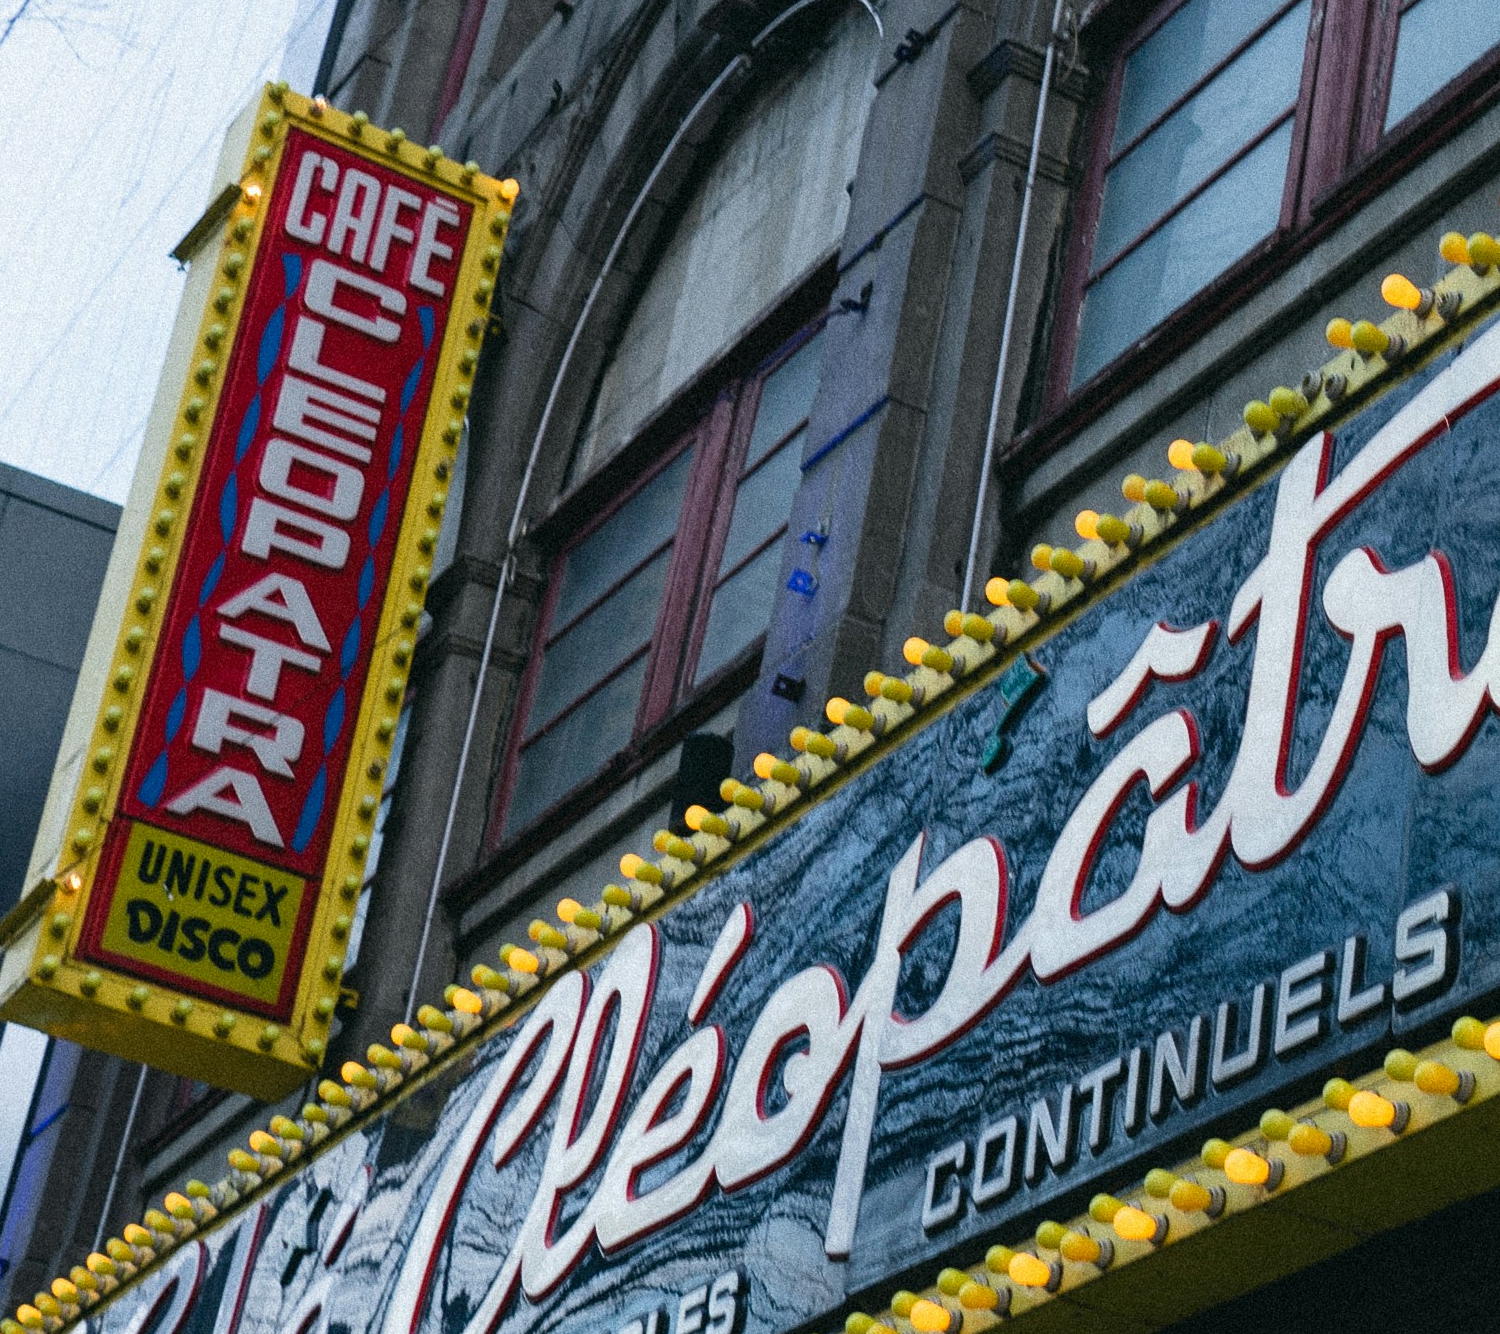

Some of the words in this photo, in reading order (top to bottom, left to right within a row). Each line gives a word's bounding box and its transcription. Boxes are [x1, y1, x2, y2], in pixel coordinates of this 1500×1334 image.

[284, 150, 461, 299] CAFÉ
[167, 258, 408, 849] CLEOPATRA
[126, 899, 276, 981] DISCO
[138, 841, 289, 929] UNISEX
[920, 890, 1460, 1233] CONTINUELS
